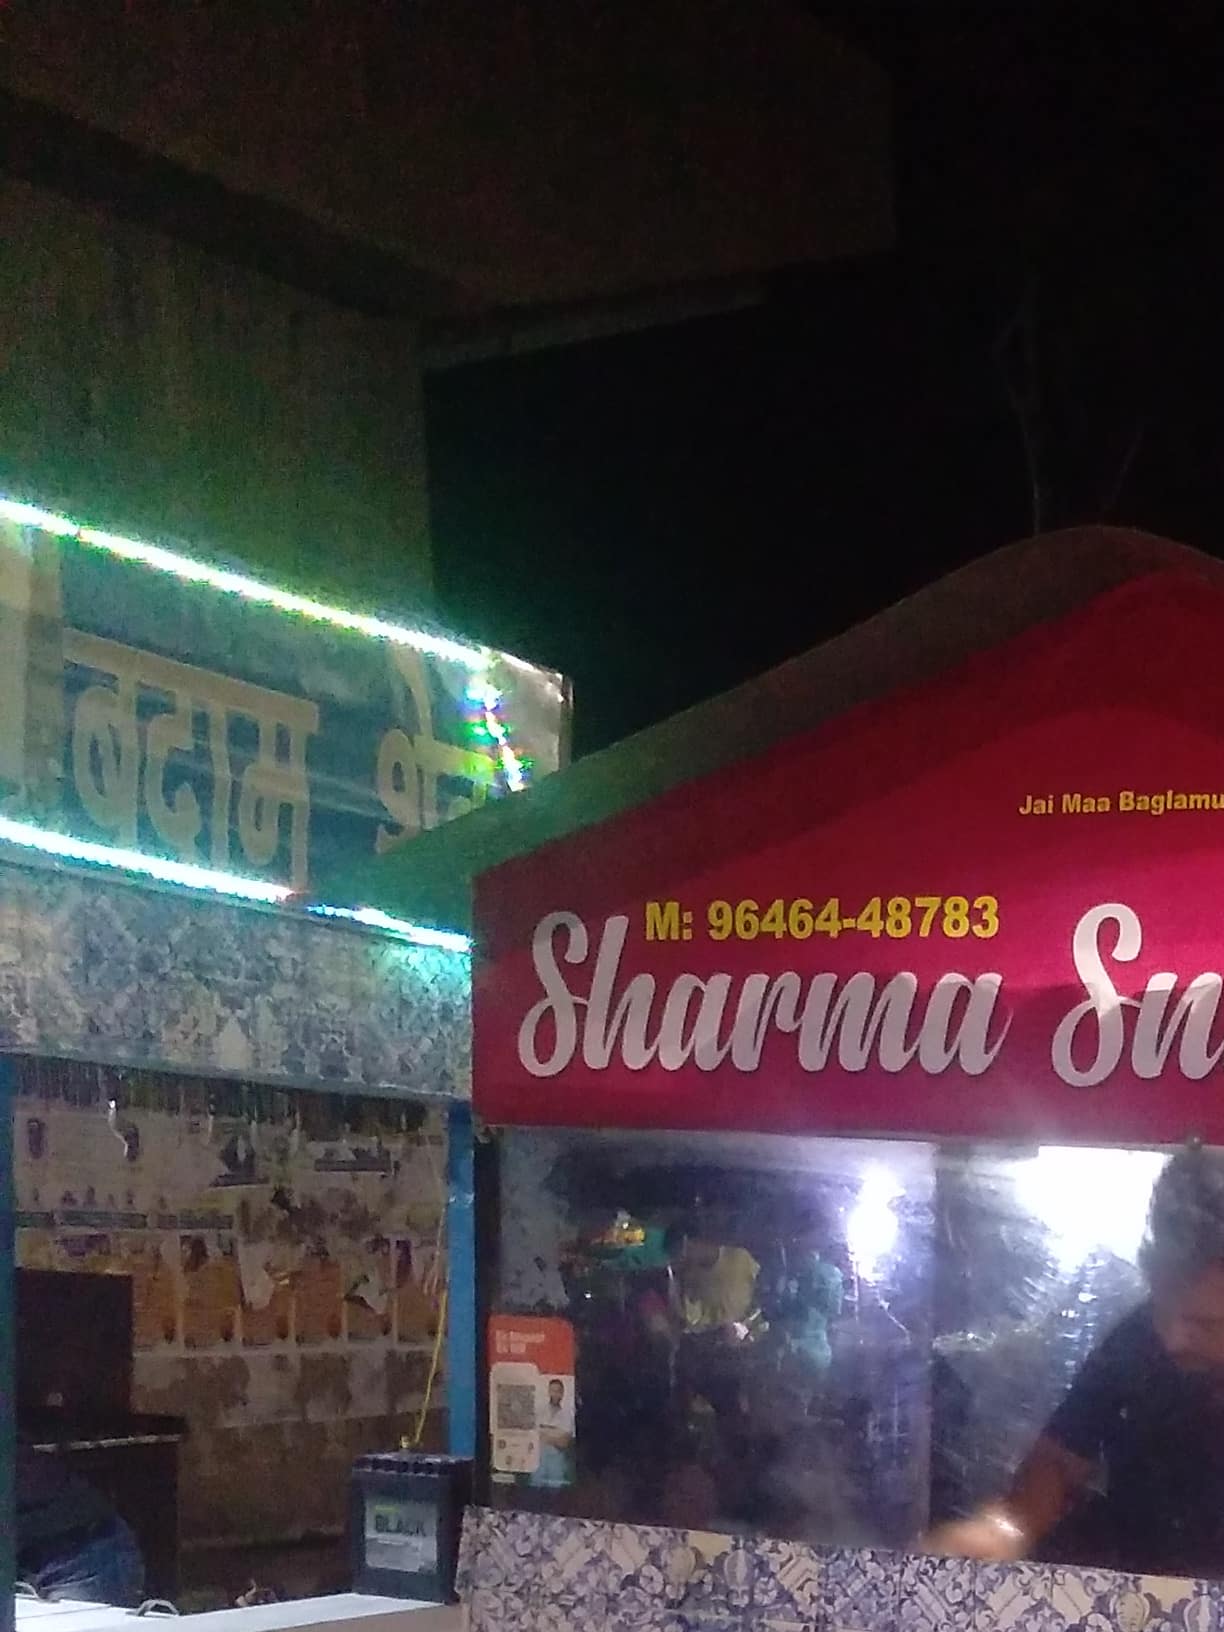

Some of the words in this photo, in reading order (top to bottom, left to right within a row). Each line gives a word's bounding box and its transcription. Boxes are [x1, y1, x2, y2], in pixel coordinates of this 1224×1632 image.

[1018, 794, 1054, 816] Jai
[1061, 792, 1111, 815] Maa
[645, 901, 693, 941] M:
[708, 896, 1001, 940] 96464-48783
[517, 910, 1014, 1078] Sharma
